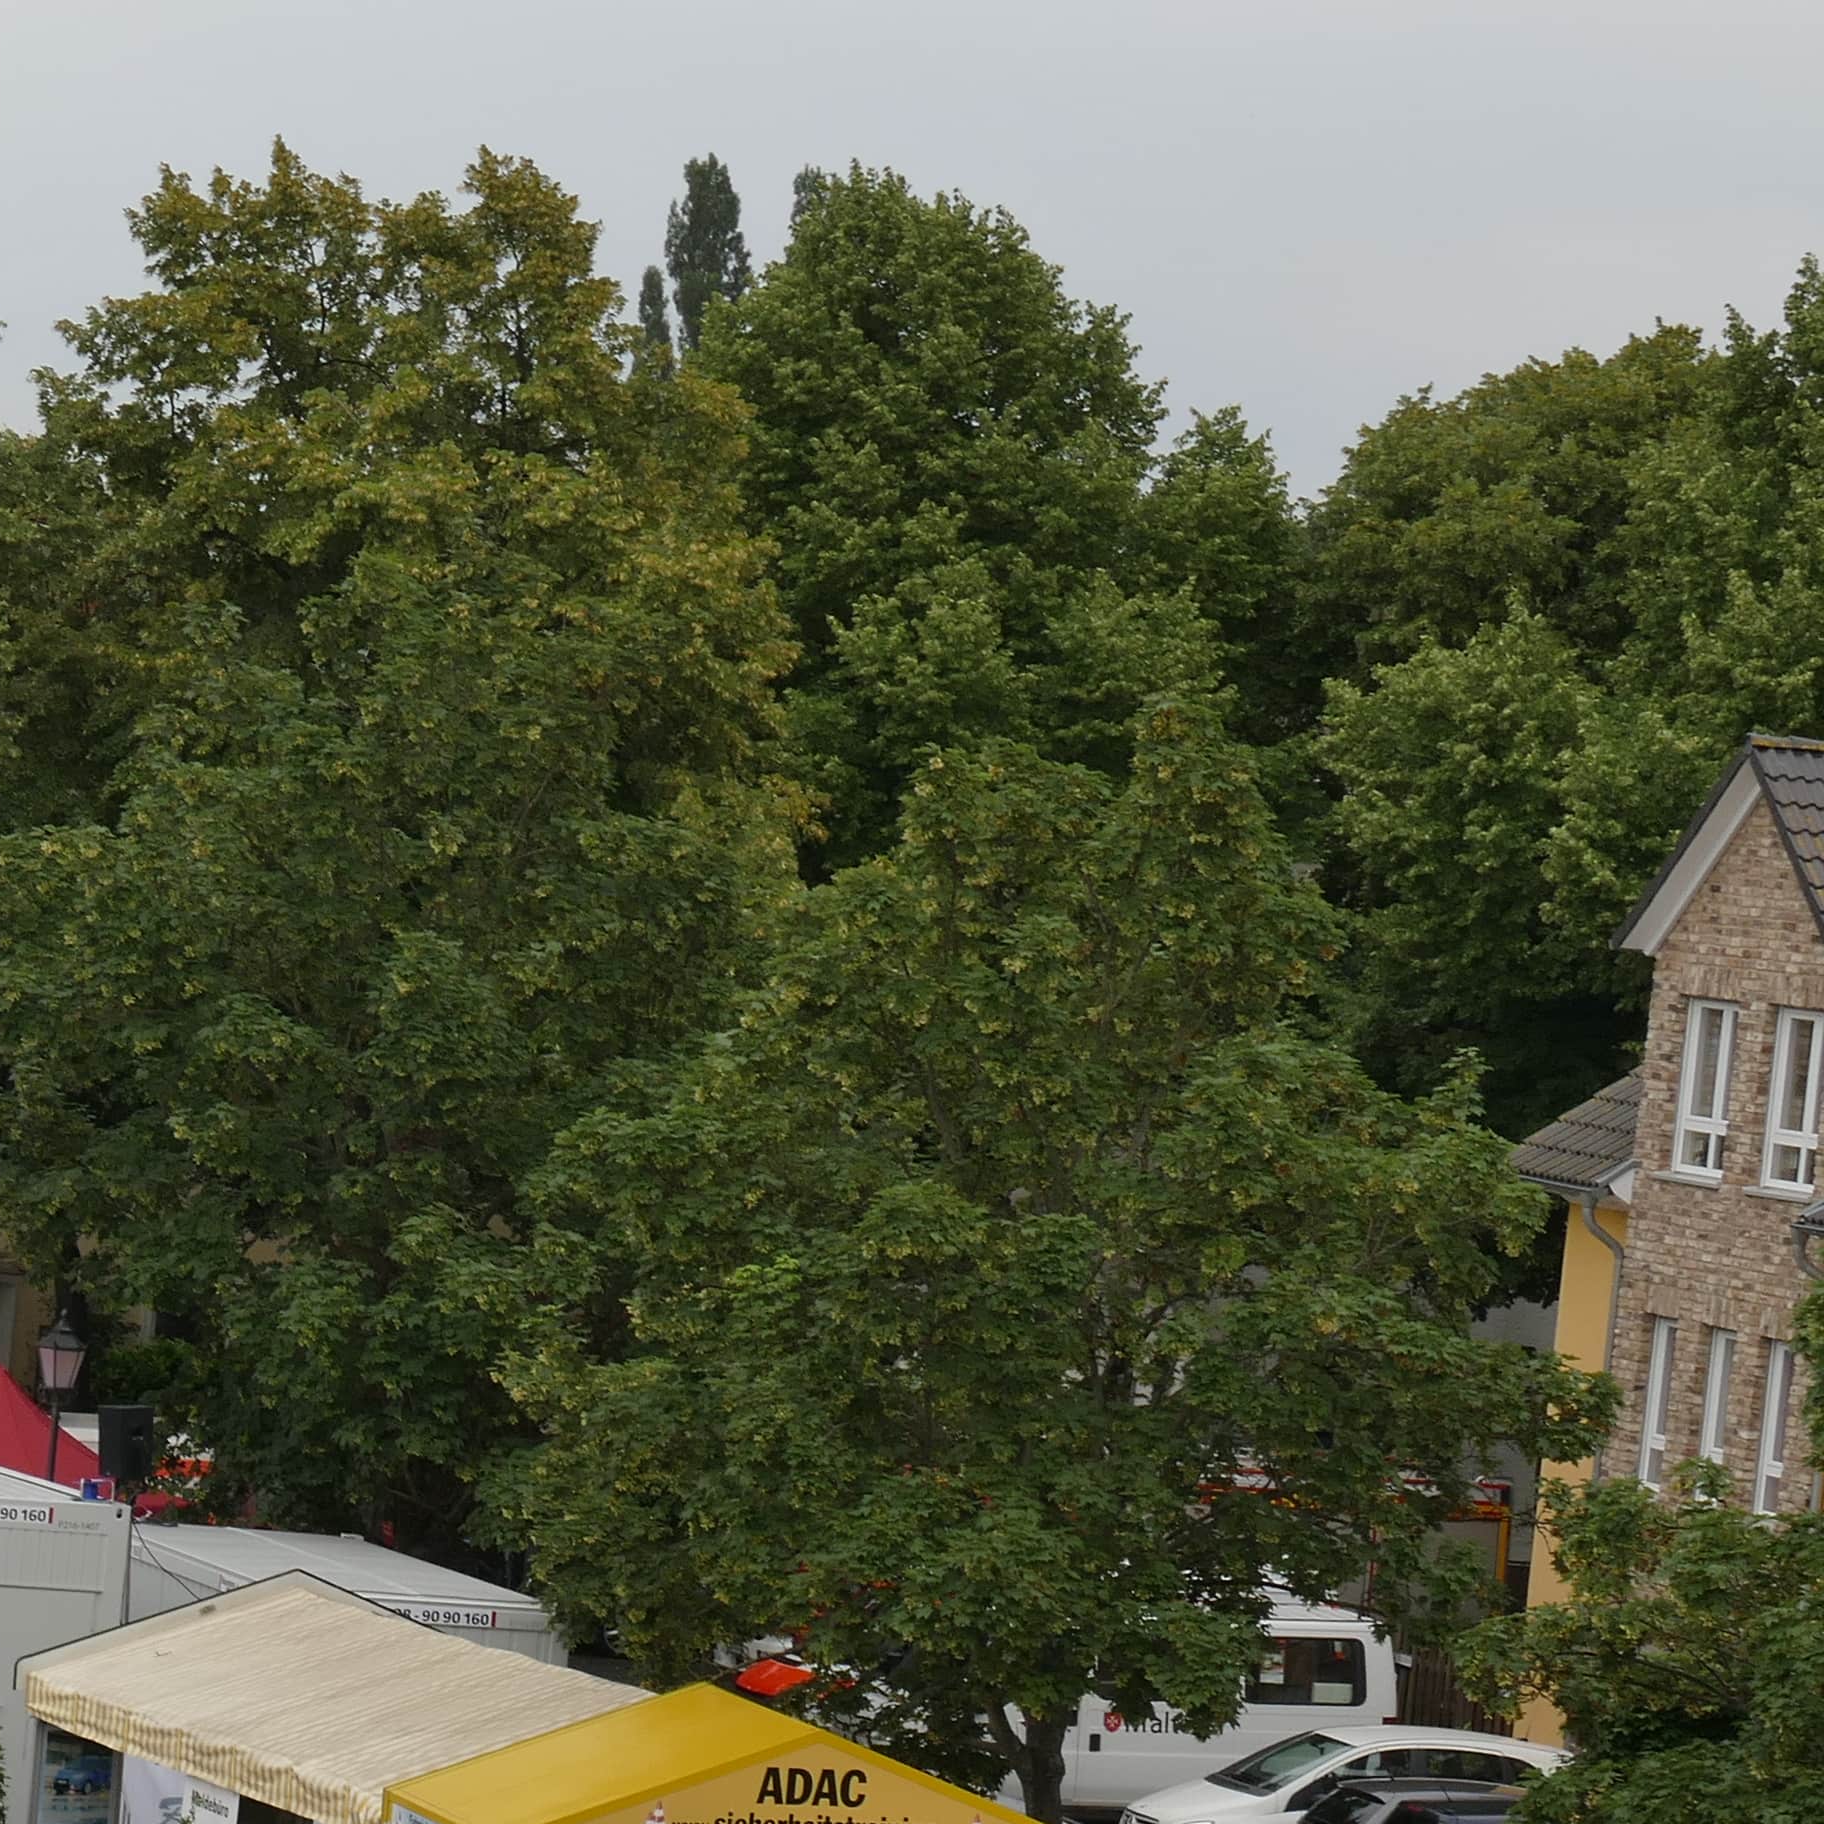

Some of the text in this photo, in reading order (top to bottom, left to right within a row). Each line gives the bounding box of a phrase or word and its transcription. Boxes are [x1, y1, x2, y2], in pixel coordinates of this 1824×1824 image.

[0, 1507, 18, 1521] 90
[21, 1509, 46, 1522] 160
[422, 1610, 440, 1624] 90
[442, 1611, 462, 1624] 90
[464, 1612, 490, 1626] 160
[756, 1766, 868, 1808] ADAC
